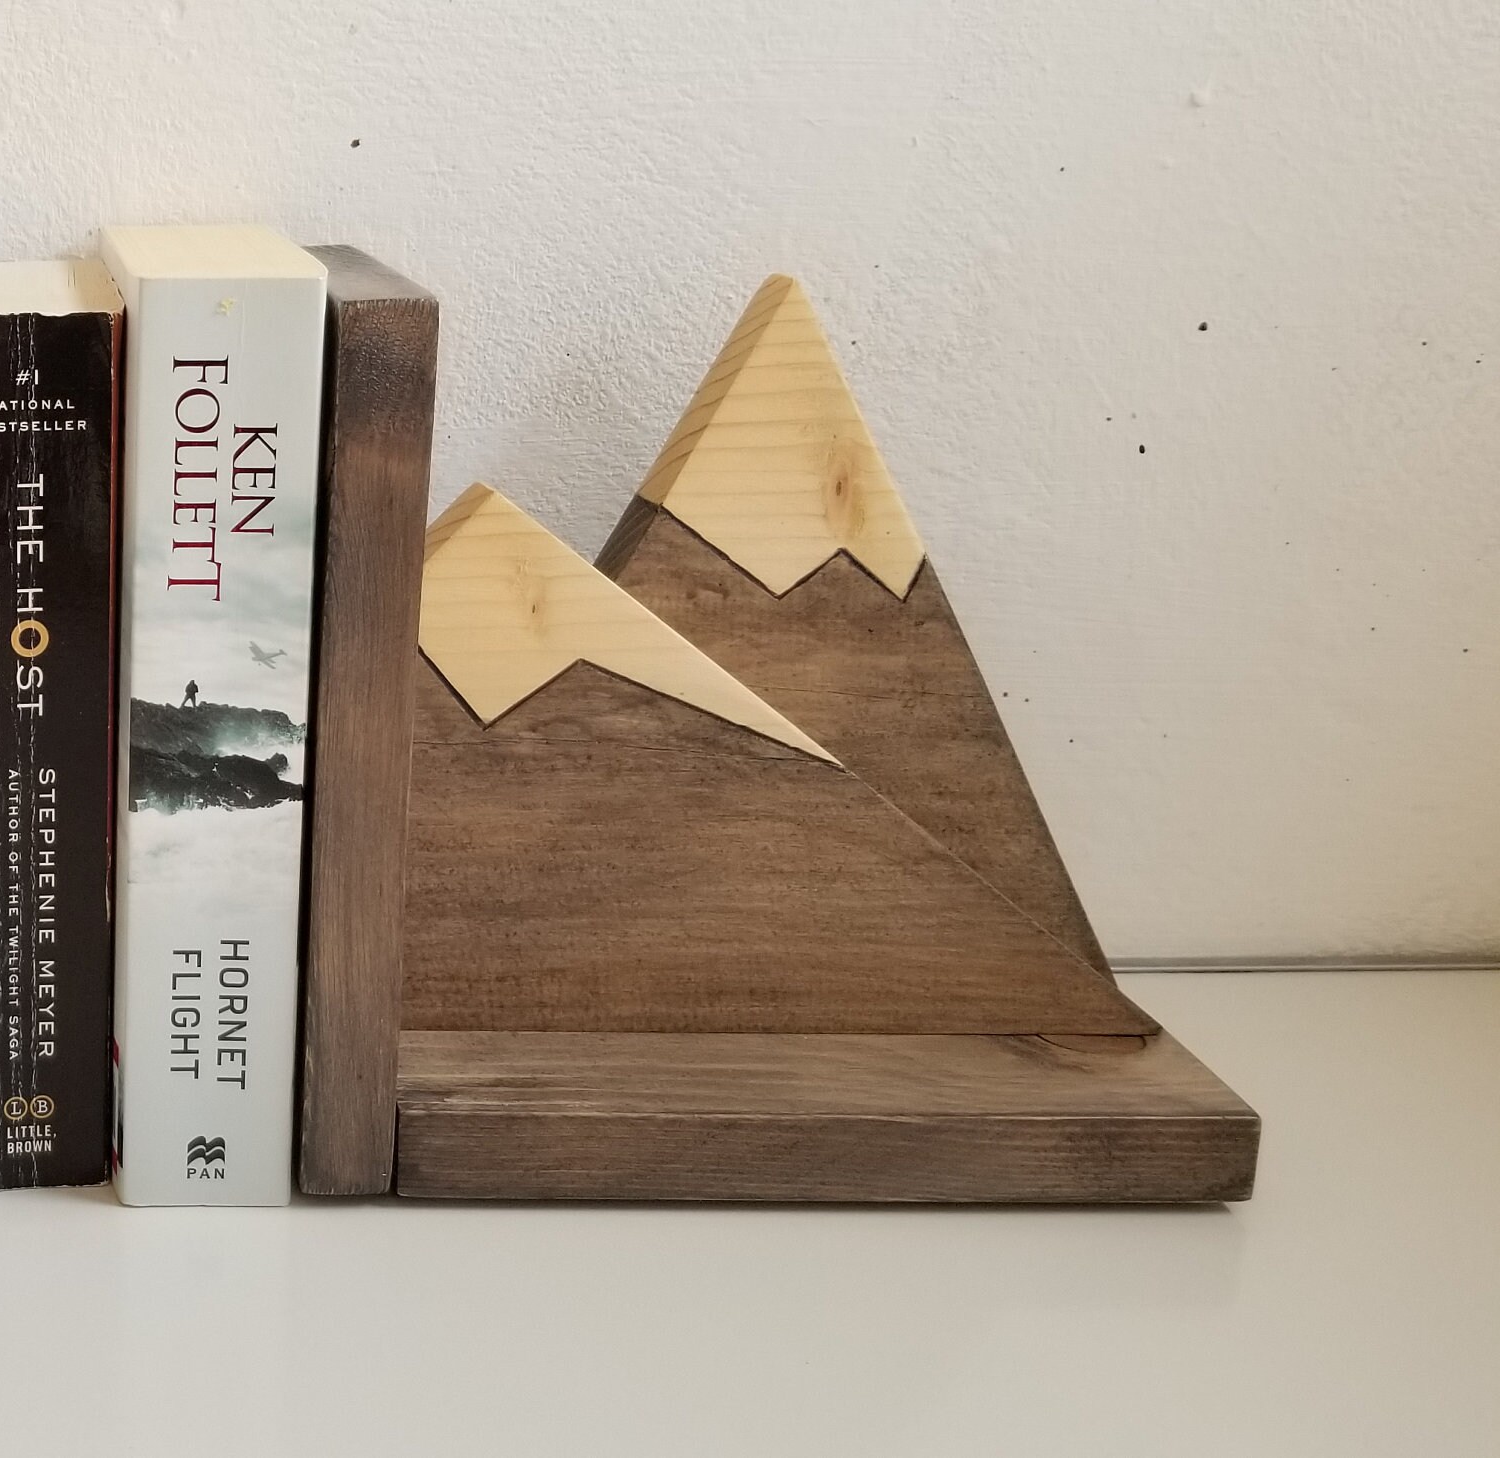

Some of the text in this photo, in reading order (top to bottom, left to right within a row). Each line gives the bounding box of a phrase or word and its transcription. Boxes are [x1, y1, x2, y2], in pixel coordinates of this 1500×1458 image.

[15, 369, 39, 386] #1
[167, 354, 229, 602] FOLLETT
[230, 422, 278, 536] KEN
[11, 473, 49, 716] THE HOST
[8, 769, 19, 1060] AUTHOR OF THE TWILIGHT SAGA
[38, 768, 56, 1057] STEPHENIE MEYER
[170, 949, 202, 1079] FLIGHT
[216, 939, 250, 1090] HORNET
[7, 1124, 57, 1139] LITTLE,
[7, 1140, 52, 1154] BROWN
[187, 1168, 225, 1179] PAN
